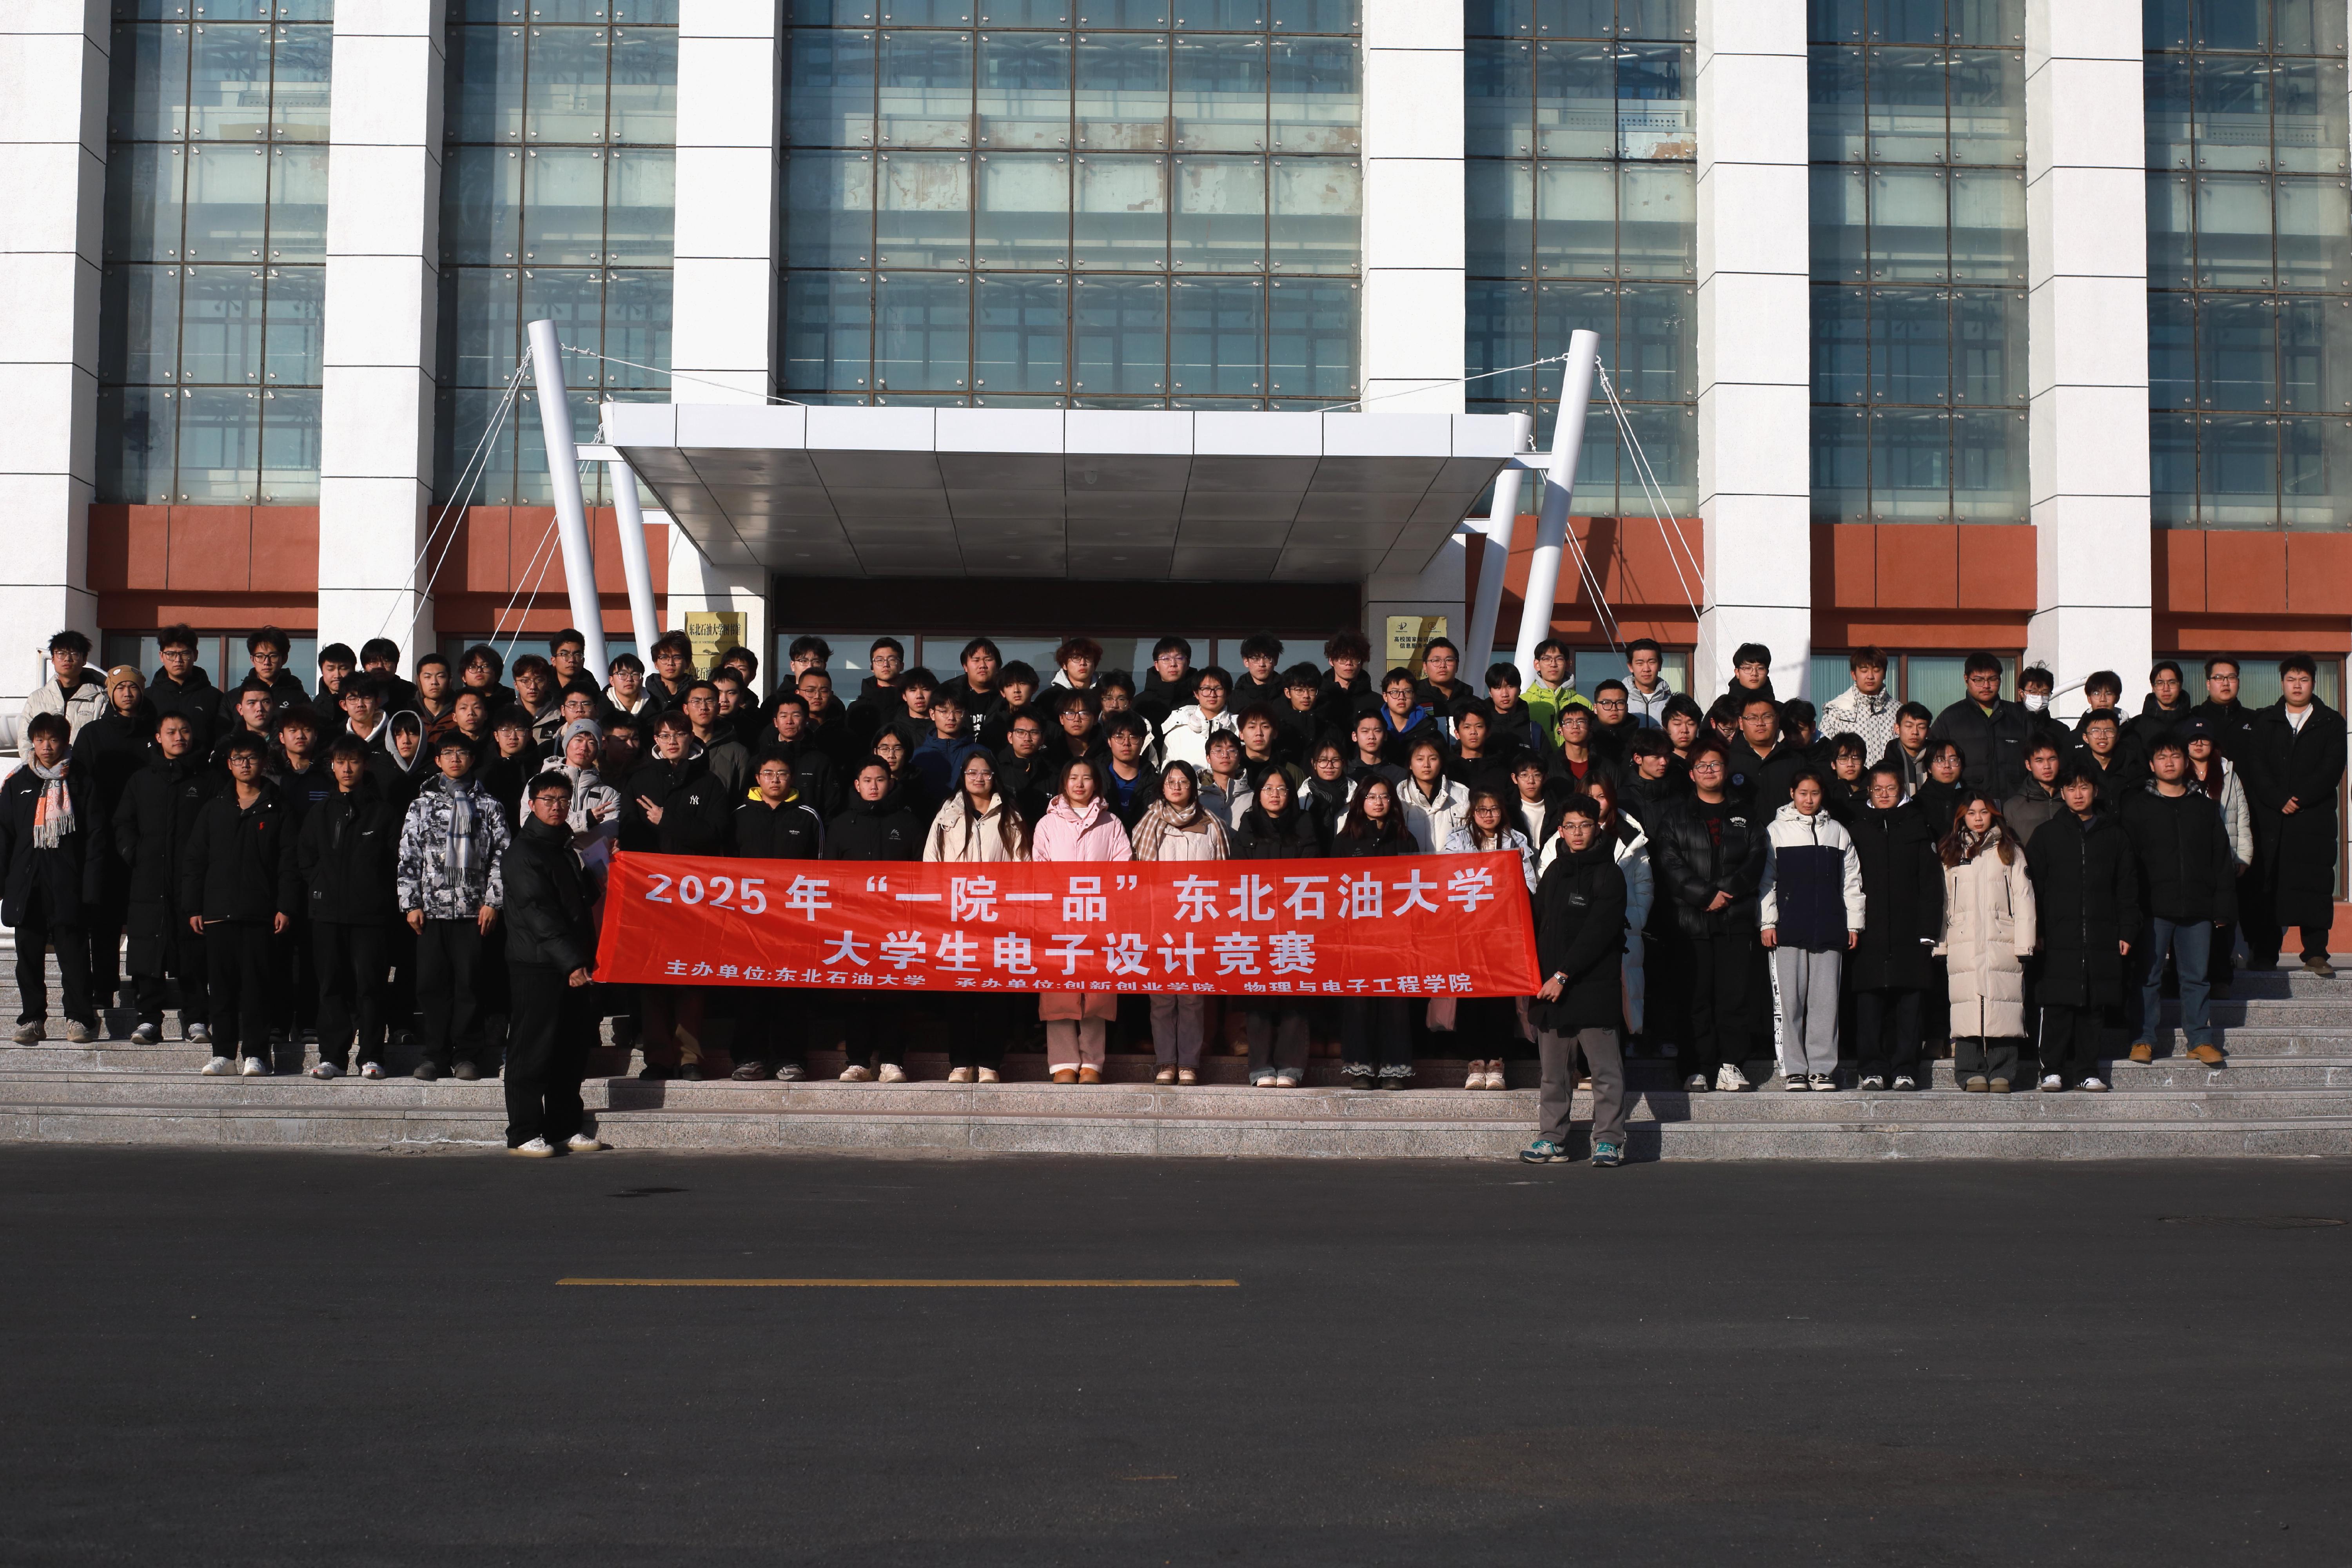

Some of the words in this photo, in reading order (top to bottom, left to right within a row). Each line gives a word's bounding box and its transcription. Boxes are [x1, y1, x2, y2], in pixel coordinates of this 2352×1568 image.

[689, 623, 740, 636] 东北石油大学图书馆
[822, 931, 1316, 976] 大学生电子设计竞赛
